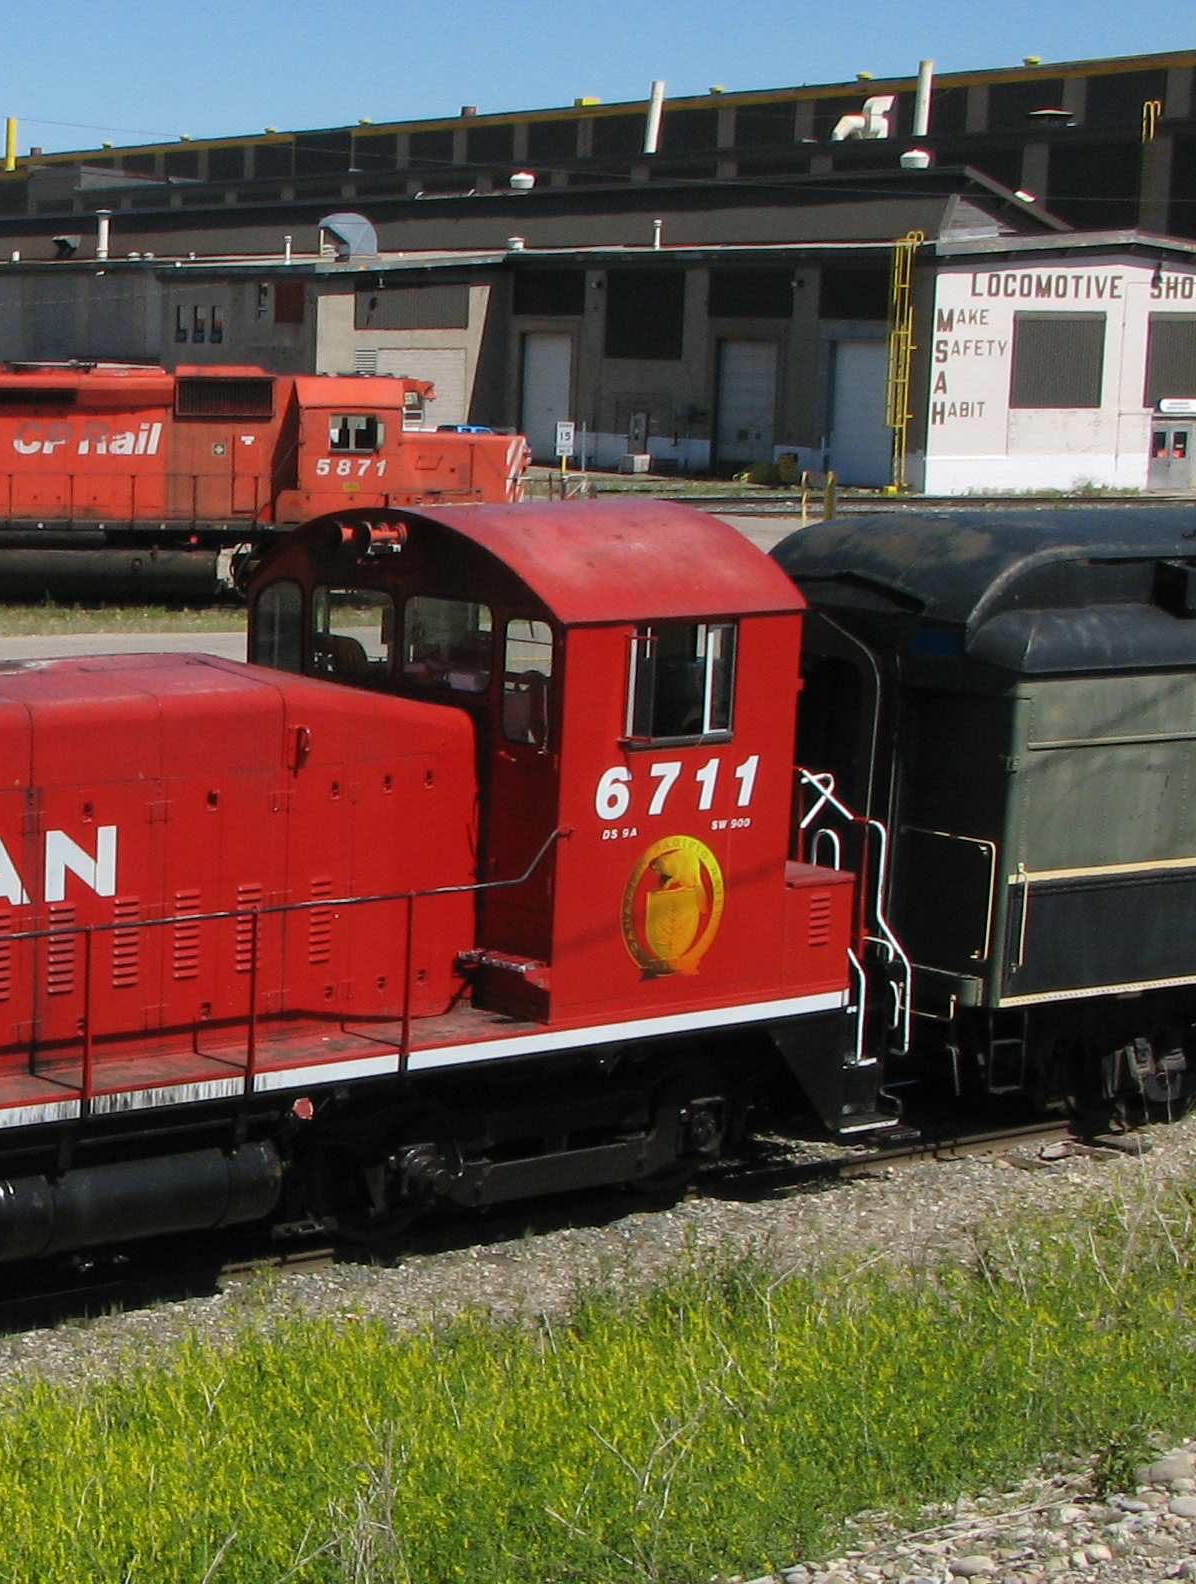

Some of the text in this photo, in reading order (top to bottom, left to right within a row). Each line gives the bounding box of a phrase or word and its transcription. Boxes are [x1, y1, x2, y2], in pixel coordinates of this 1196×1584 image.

[970, 272, 1123, 300] LOCOMOTIVE
[936, 308, 990, 333] MAKE
[935, 339, 1008, 364] SAFETY
[933, 370, 948, 395] A
[931, 401, 986, 426] HABIT
[77, 421, 164, 456] Rail
[559, 431, 572, 442] 15
[315, 457, 387, 477] 5871
[595, 755, 760, 821] 6711
[602, 827, 638, 840] DS 9A
[710, 817, 751, 831] SW 900
